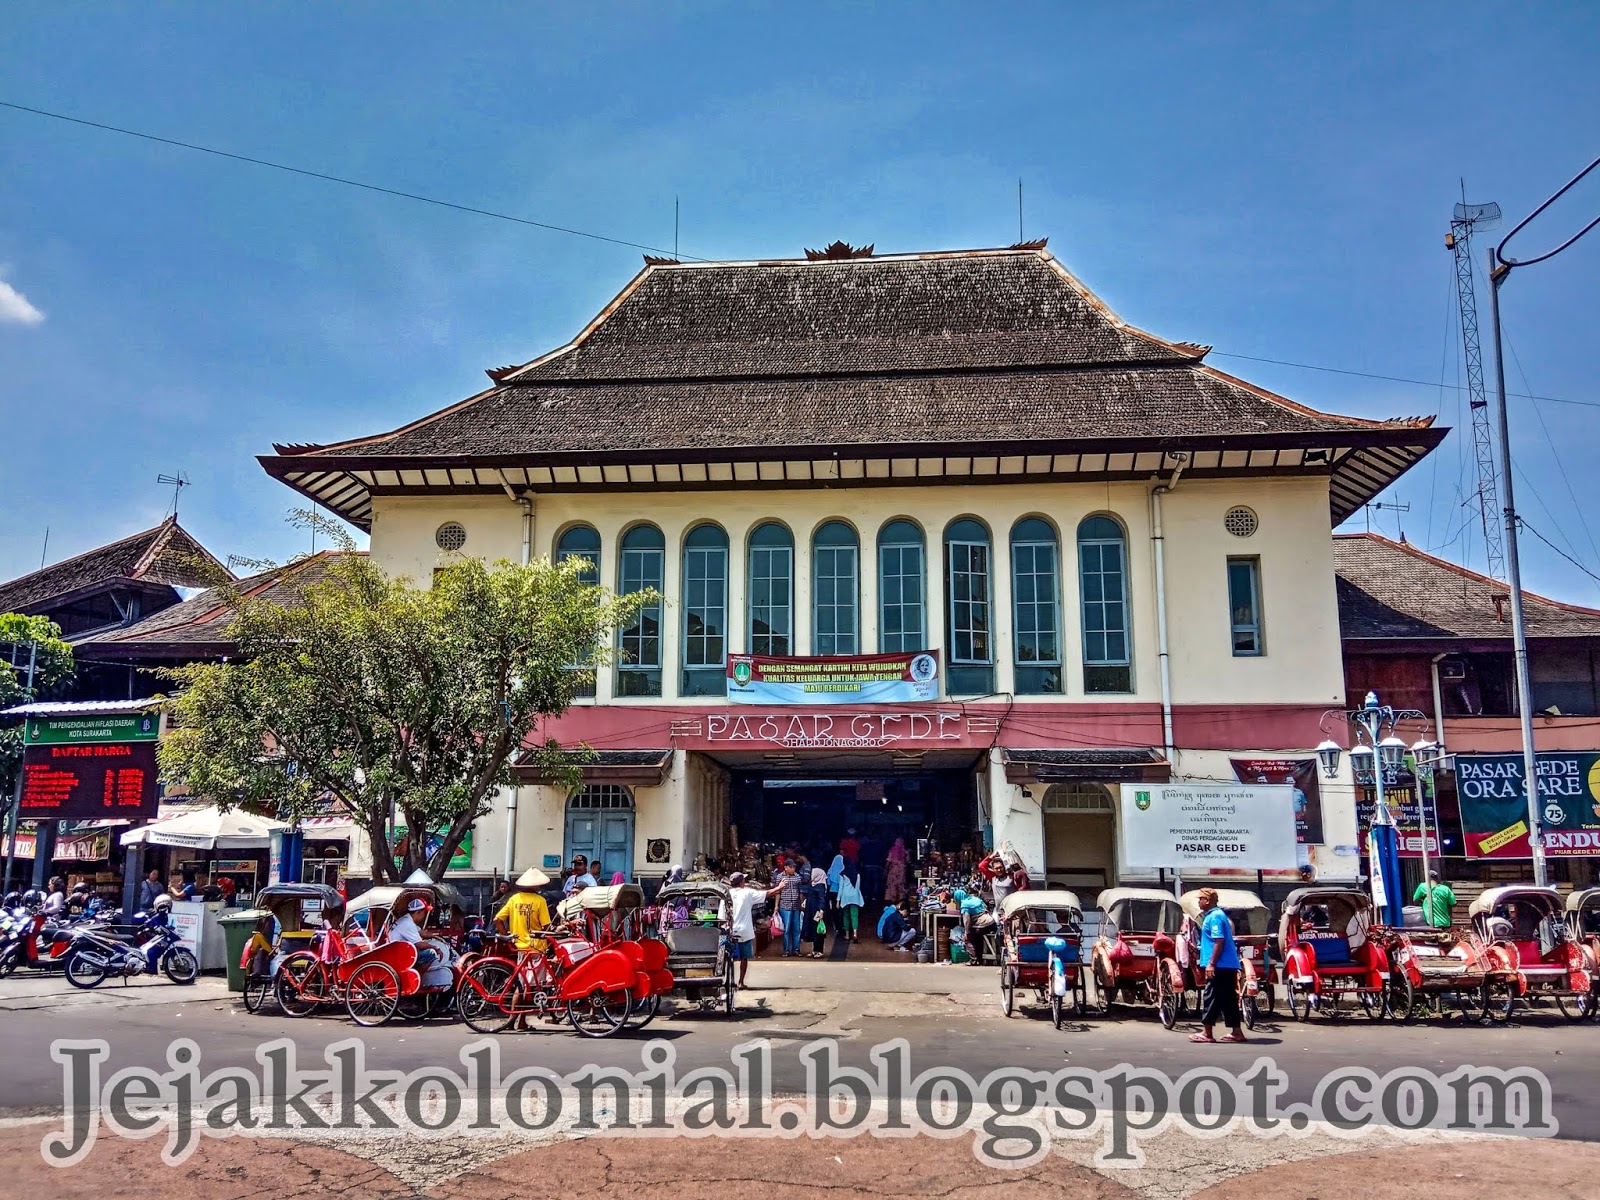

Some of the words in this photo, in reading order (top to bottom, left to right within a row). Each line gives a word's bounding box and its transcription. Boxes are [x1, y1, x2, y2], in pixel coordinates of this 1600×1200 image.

[758, 664, 785, 673] DENGAN
[786, 664, 822, 673] SEMANGAT
[823, 663, 851, 672] KARTINI
[852, 663, 868, 671] KITA
[869, 662, 907, 671] WUJUDKAN
[763, 674, 795, 682] KUALITAS
[796, 674, 831, 683] KELUARGA
[831, 674, 855, 682] UNTUK
[855, 673, 875, 682] JAWA
[875, 672, 902, 681] TENGAH
[803, 684, 824, 693] MAJU
[824, 684, 861, 692] BERDIKARI
[57, 721, 95, 729] PENGENDALIAN
[114, 719, 136, 727] DAERAH
[707, 714, 834, 740] PASAR
[851, 713, 961, 740] GEDE
[83, 729, 112, 737] SURAKARTA
[789, 738, 878, 747] HARDJONAGORO
[52, 747, 92, 757] DAFTAR
[94, 746, 132, 756] HARGA
[1459, 762, 1522, 779] PASAR
[1463, 780, 1517, 798] ORA
[1547, 809, 1561, 819] 75
[1175, 843, 1212, 852] PASAR
[1216, 843, 1246, 852] GEDE
